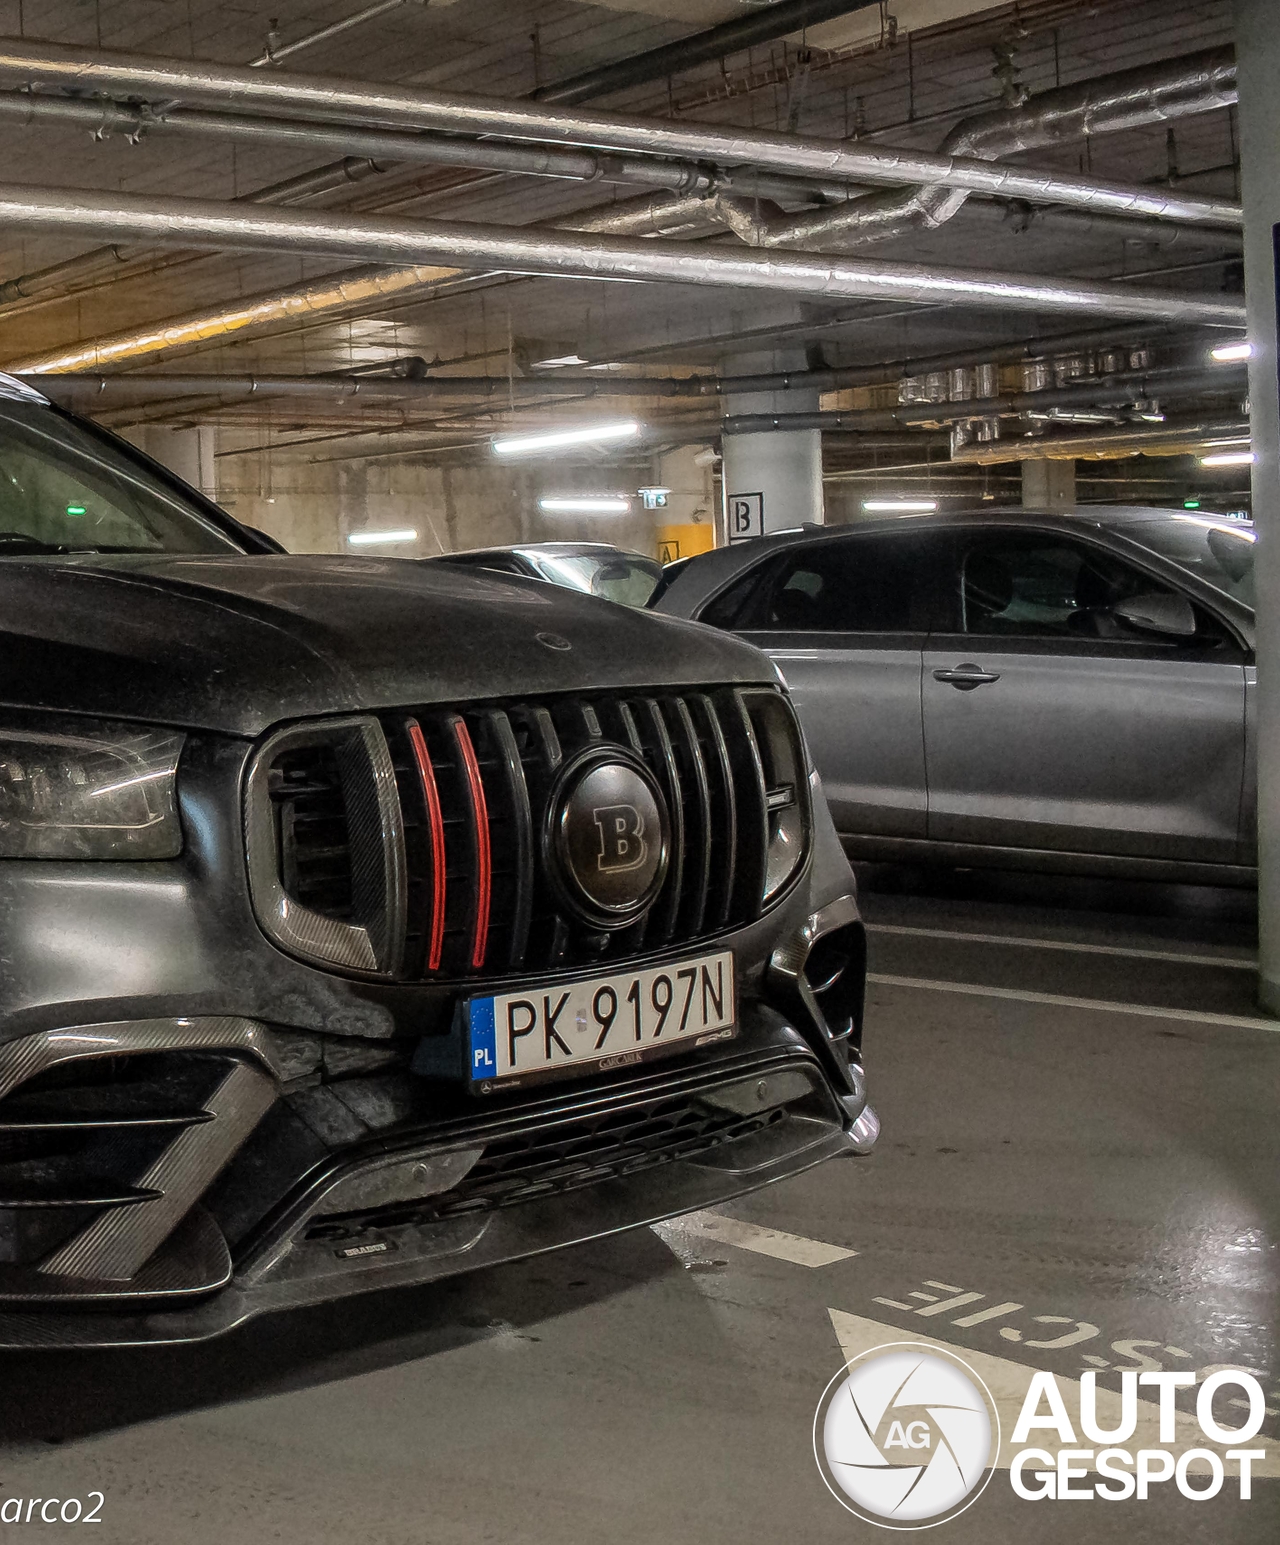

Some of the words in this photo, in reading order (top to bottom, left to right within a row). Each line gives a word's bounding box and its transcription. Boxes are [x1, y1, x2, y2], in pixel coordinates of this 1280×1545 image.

[735, 501, 750, 532] B
[593, 804, 648, 874] B
[506, 990, 573, 1067] PK
[592, 960, 724, 1050] 9197N
[474, 1048, 493, 1067] PL
